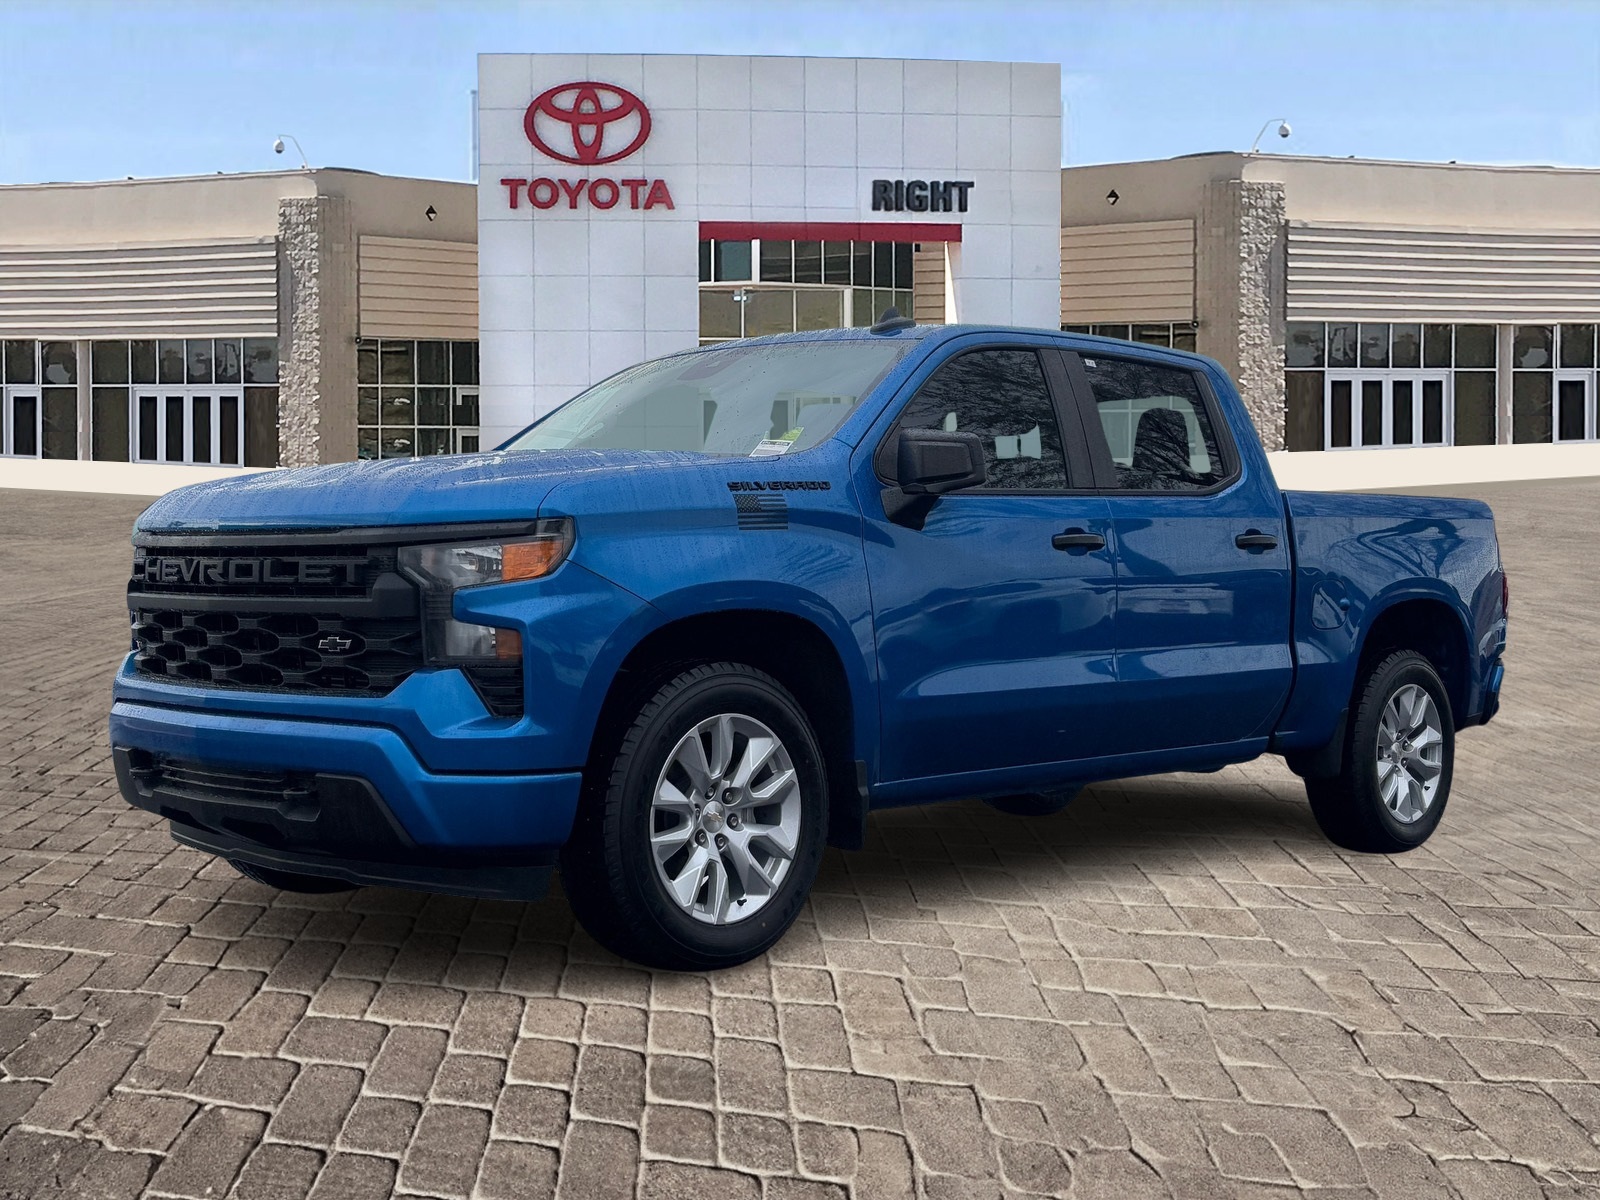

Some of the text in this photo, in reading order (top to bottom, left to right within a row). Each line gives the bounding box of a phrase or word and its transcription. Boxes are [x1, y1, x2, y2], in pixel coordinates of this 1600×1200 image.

[501, 178, 675, 210] TOYOTA
[872, 180, 974, 212] RIGHT
[727, 481, 831, 491] SILVERADO
[132, 558, 369, 583] CHEVROLET
